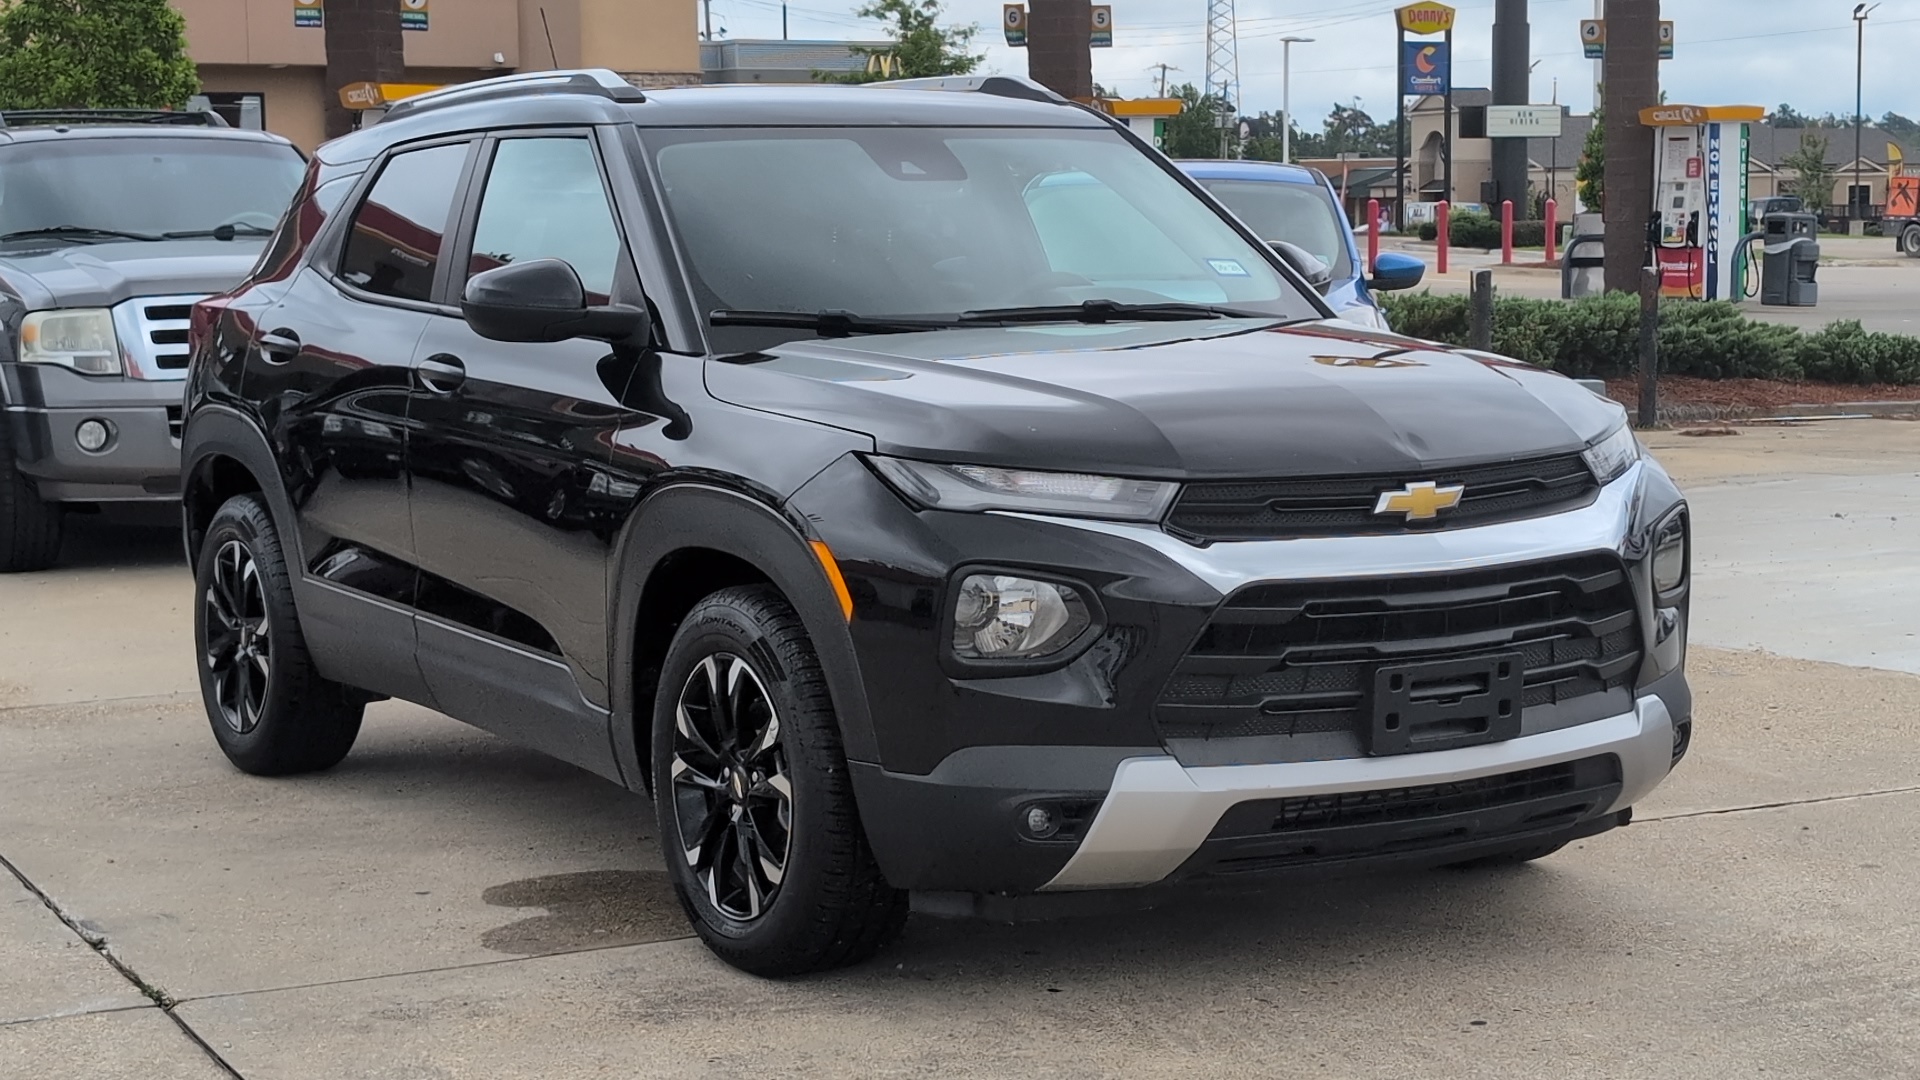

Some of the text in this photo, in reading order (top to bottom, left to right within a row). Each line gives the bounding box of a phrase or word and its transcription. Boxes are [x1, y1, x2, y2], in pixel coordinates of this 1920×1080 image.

[1009, 11, 1017, 23] 6
[1096, 12, 1105, 24] 5
[1409, 8, 1450, 26] Denny's
[1586, 26, 1595, 36] 4
[1662, 27, 1669, 39] 3
[1652, 109, 1682, 121] CIRCLE
[1740, 138, 1748, 211] DIESEL
[1707, 138, 1719, 264] NON ETHANOL
